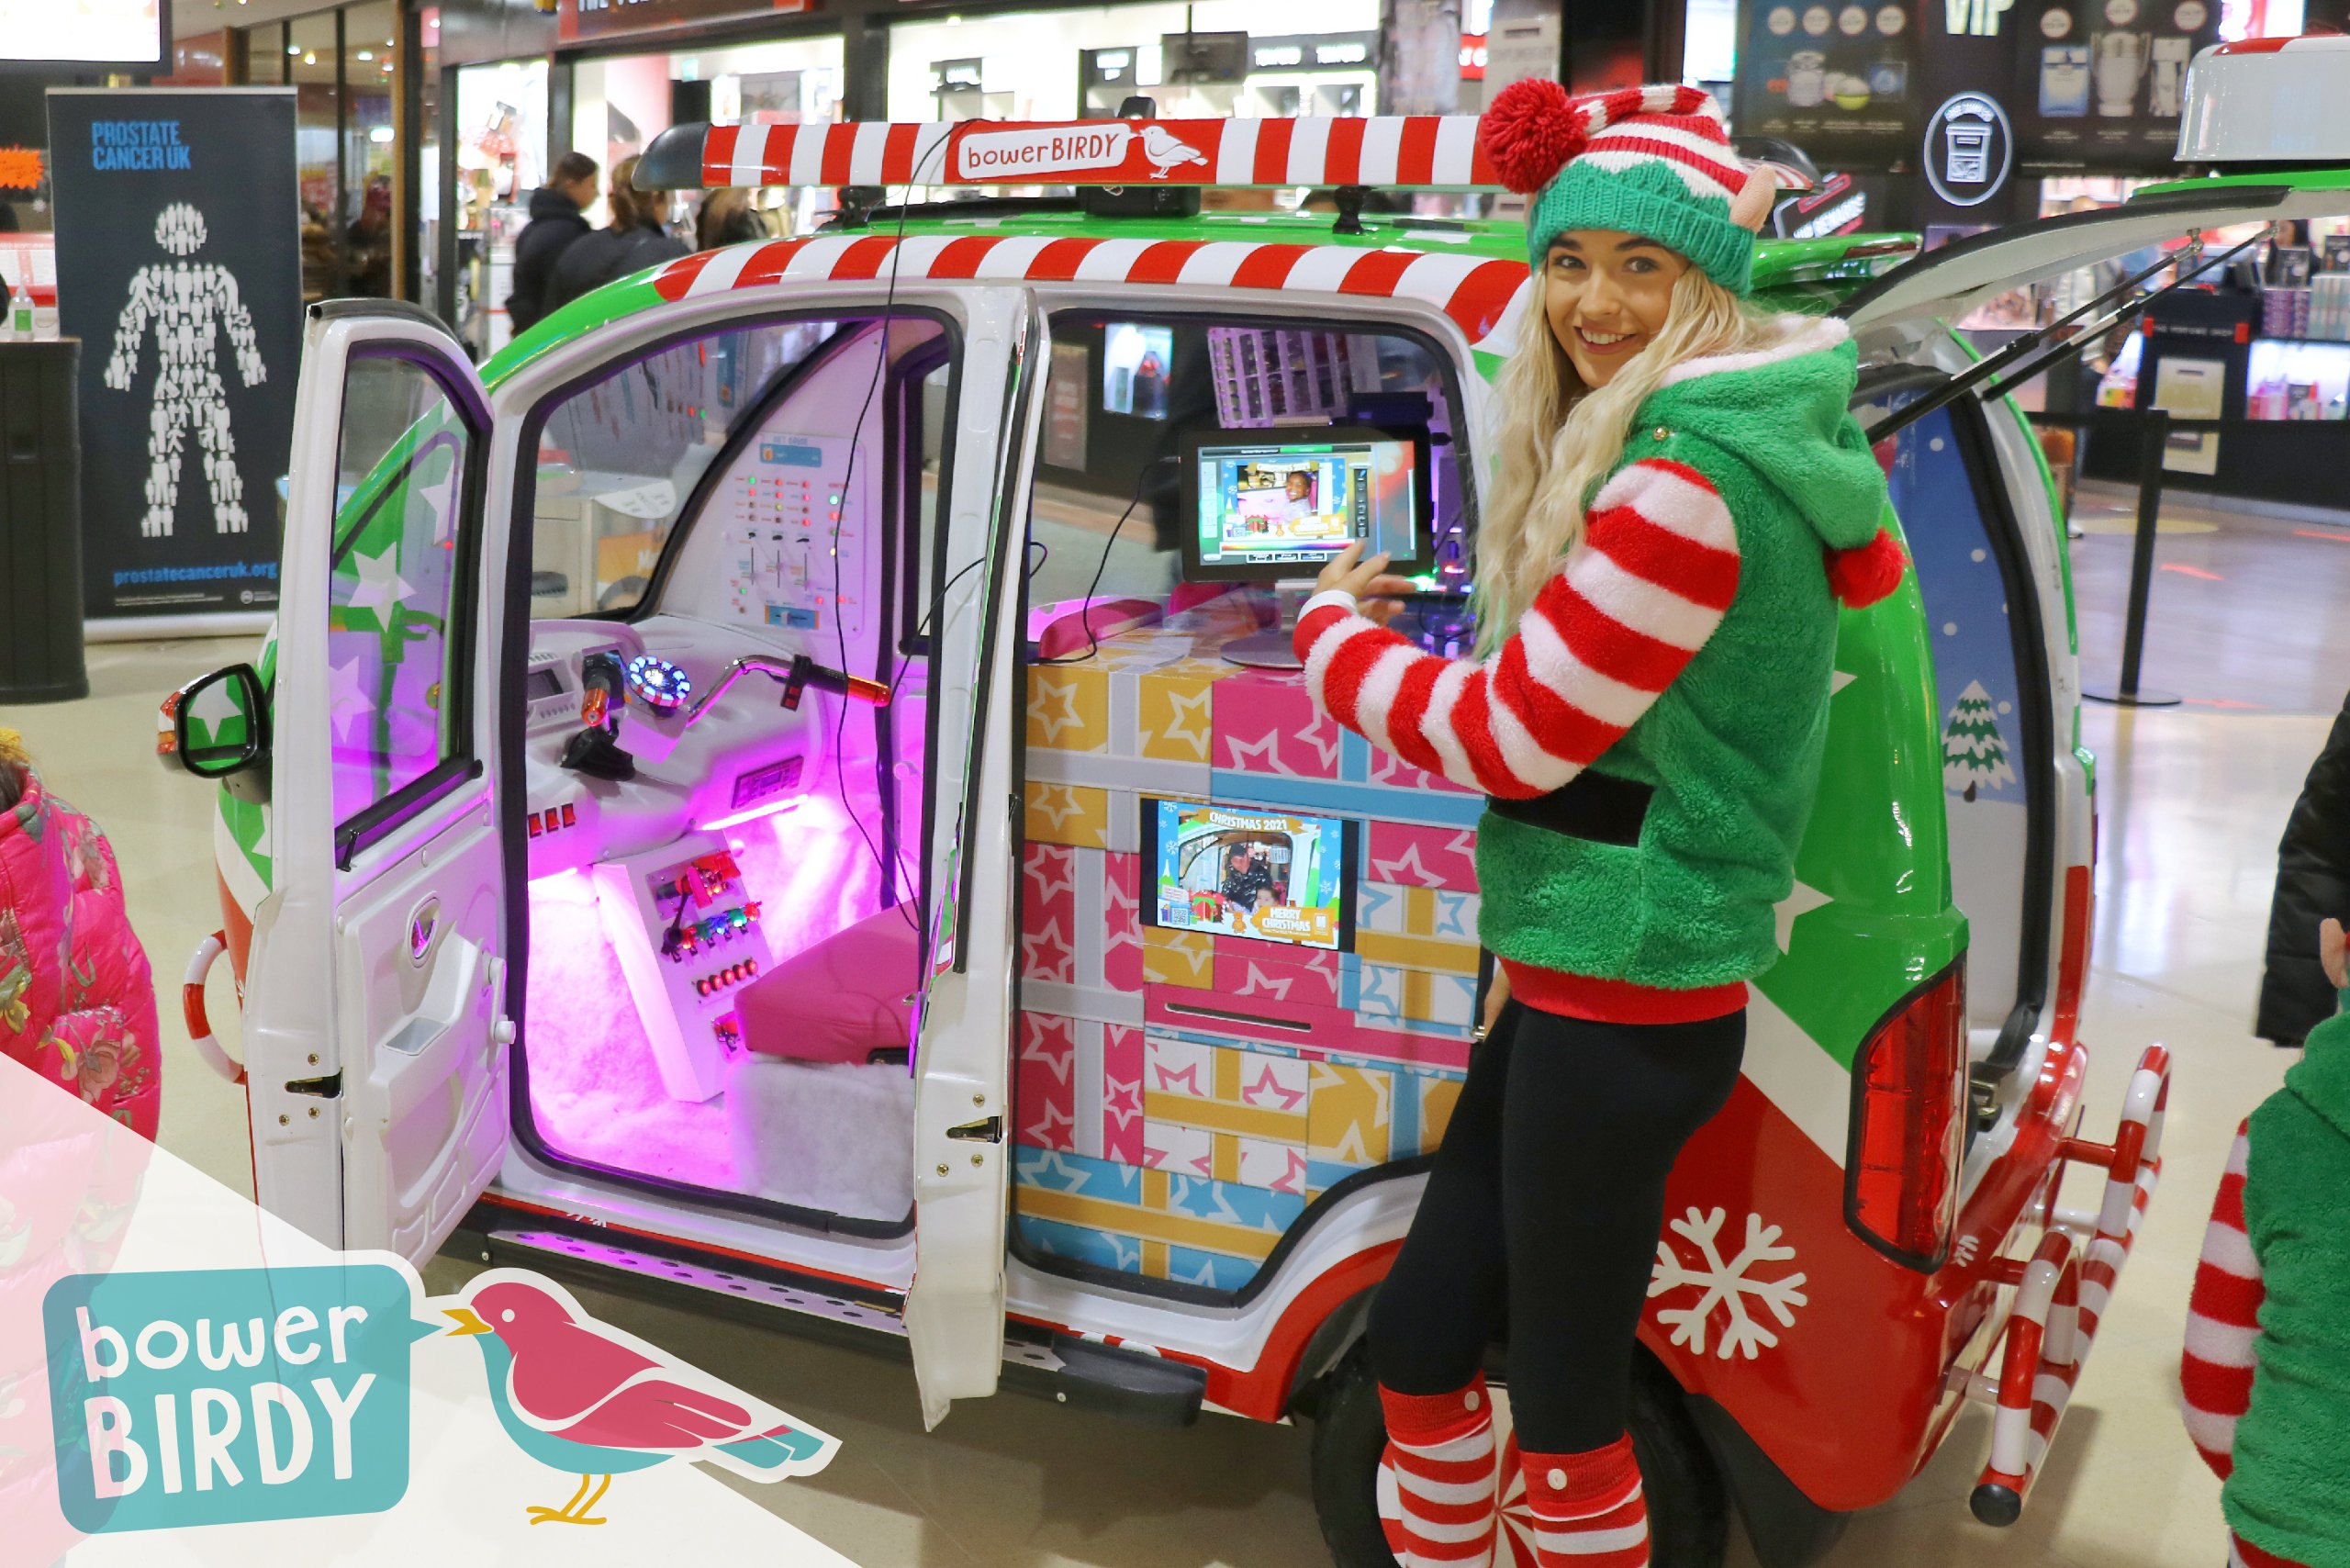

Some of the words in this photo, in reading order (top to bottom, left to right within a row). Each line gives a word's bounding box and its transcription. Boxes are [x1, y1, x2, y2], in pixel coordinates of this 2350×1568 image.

[92, 120, 180, 146] PROSTATE
[93, 146, 164, 170] CANCER
[165, 145, 191, 169] UK
[968, 132, 1120, 169] bowerBIRDY
[113, 560, 278, 588] prostatecanceruk.org
[1209, 811, 1262, 831] CHRISTMAS
[1261, 917, 1312, 932] CHRISTMAS
[1270, 907, 1302, 920] MERRY
